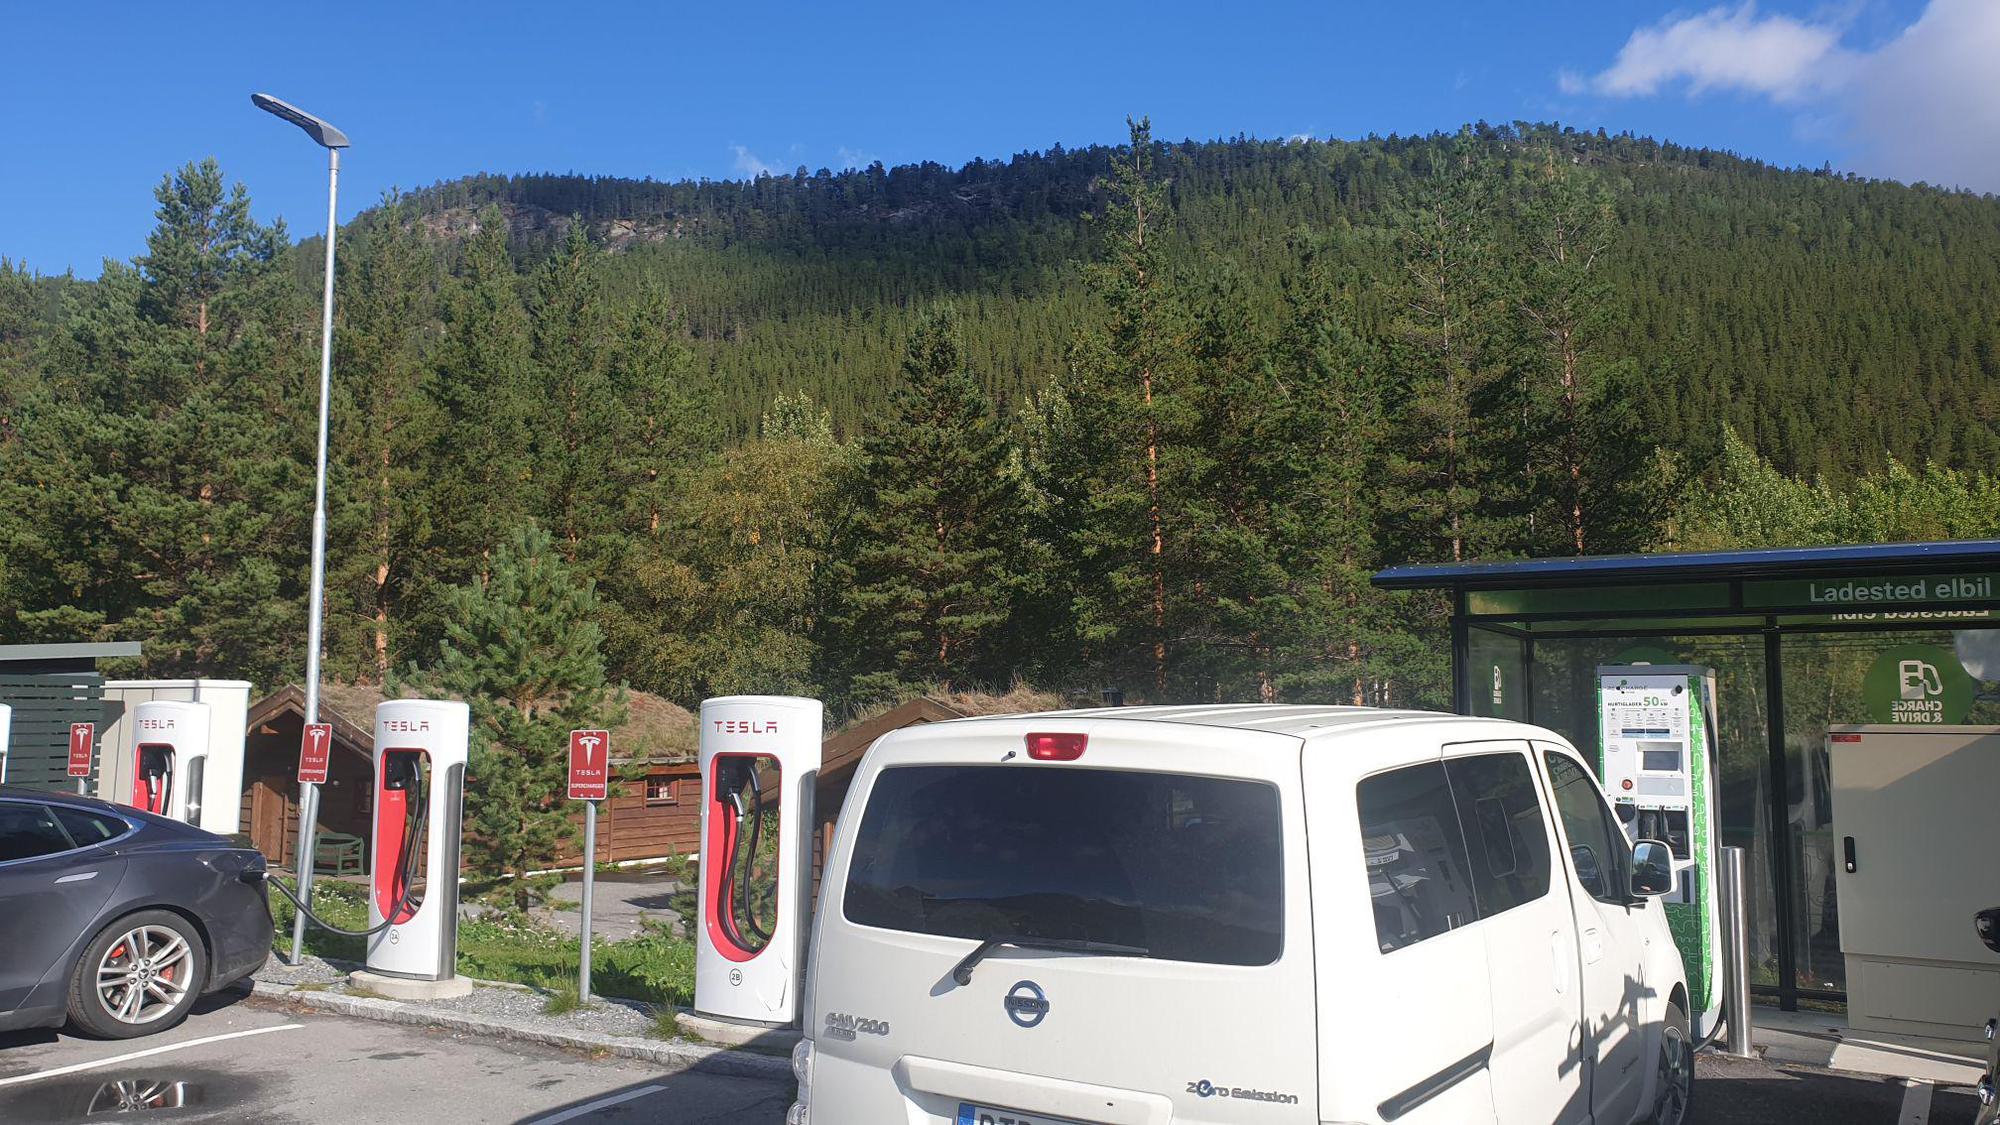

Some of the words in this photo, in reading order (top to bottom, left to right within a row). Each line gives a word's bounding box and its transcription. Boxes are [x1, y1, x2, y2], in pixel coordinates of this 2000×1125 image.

[1810, 579, 1926, 602] Ladested
[1935, 577, 1991, 598] elbil
[1643, 696, 1660, 707] 50
[139, 720, 175, 729] TESLA
[384, 721, 429, 731] TESLA
[714, 721, 778, 734] TESLA
[1008, 999, 1045, 1010] NISSAN
[1231, 1088, 1298, 1105] Emission
